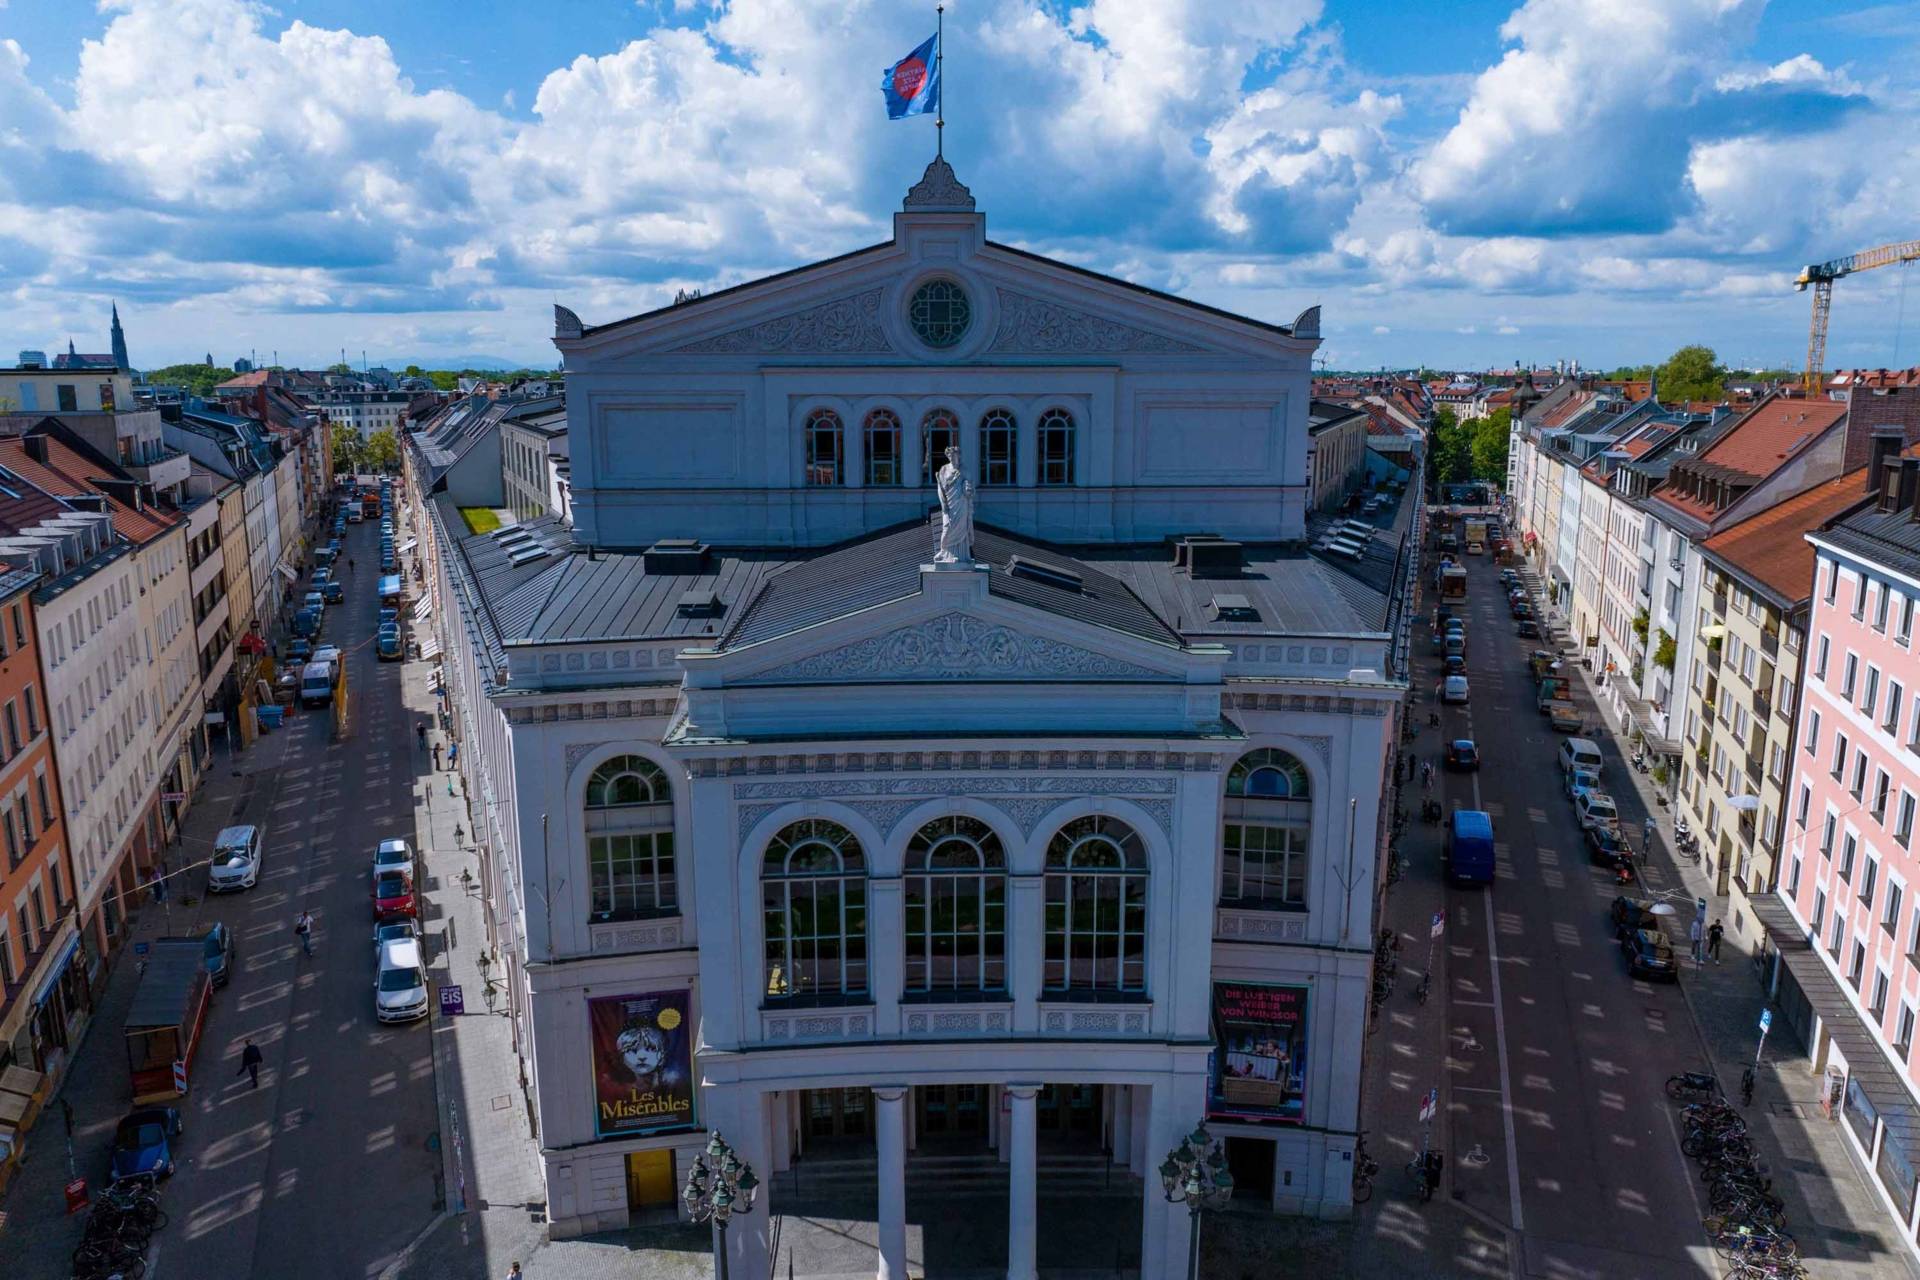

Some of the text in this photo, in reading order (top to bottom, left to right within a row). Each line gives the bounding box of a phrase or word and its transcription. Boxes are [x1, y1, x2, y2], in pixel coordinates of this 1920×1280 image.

[441, 991, 462, 1005] EIS
[1225, 990, 1296, 1002] DIE LUSTIGEN
[1222, 1008, 1298, 1020] VON WINDSOR
[631, 1088, 655, 1102] Les
